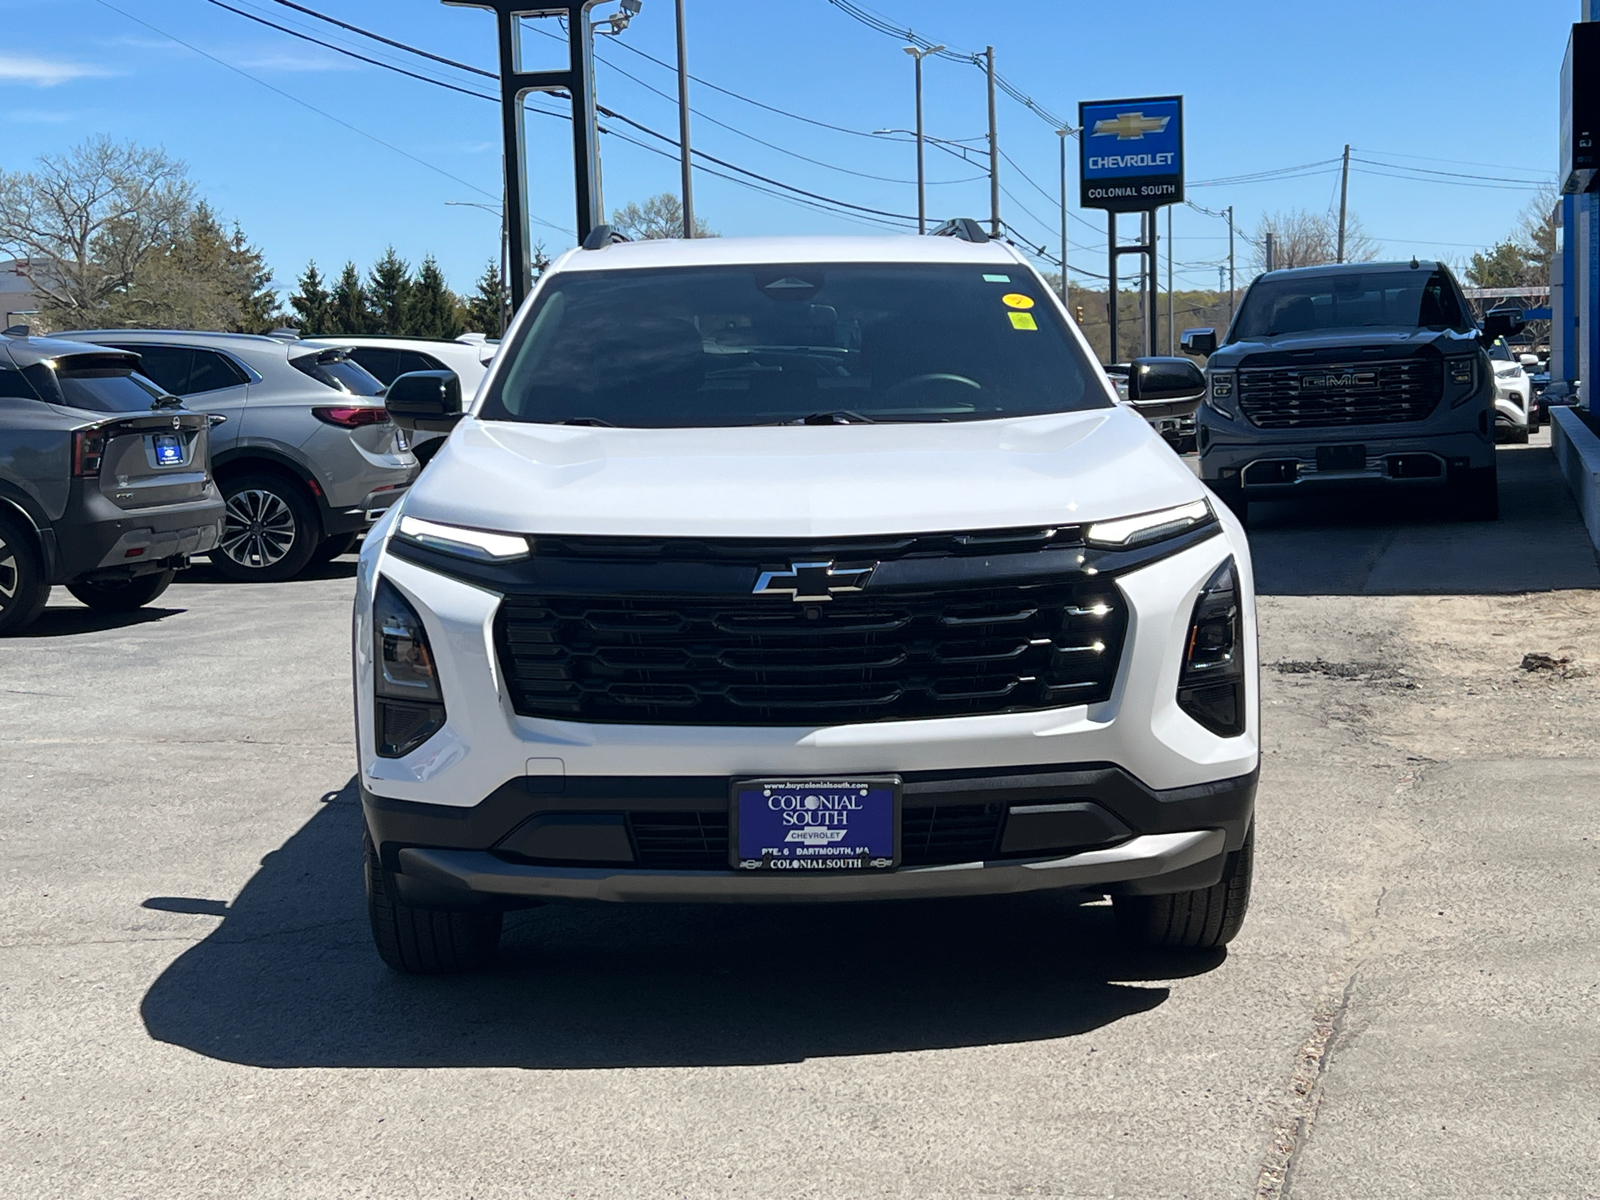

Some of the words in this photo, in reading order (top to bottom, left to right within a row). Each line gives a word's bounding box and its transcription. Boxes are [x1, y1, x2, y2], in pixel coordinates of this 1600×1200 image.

[1088, 152, 1175, 169] CHEVROLET
[1088, 187, 1138, 199] COLONIAL
[1141, 184, 1175, 196] SOUTH
[1302, 373, 1375, 388] GMC
[764, 782, 868, 790] www.buycolonialsouth.com
[768, 795, 863, 811] COLONIAL
[783, 811, 848, 826] SOUTH
[791, 831, 841, 840] CHEVROLET
[783, 848, 789, 856] 6
[796, 847, 854, 856] DARTMOUTH,
[856, 847, 869, 855] MA
[770, 860, 826, 869] COLONIAL
[826, 859, 862, 869] SOUTH
